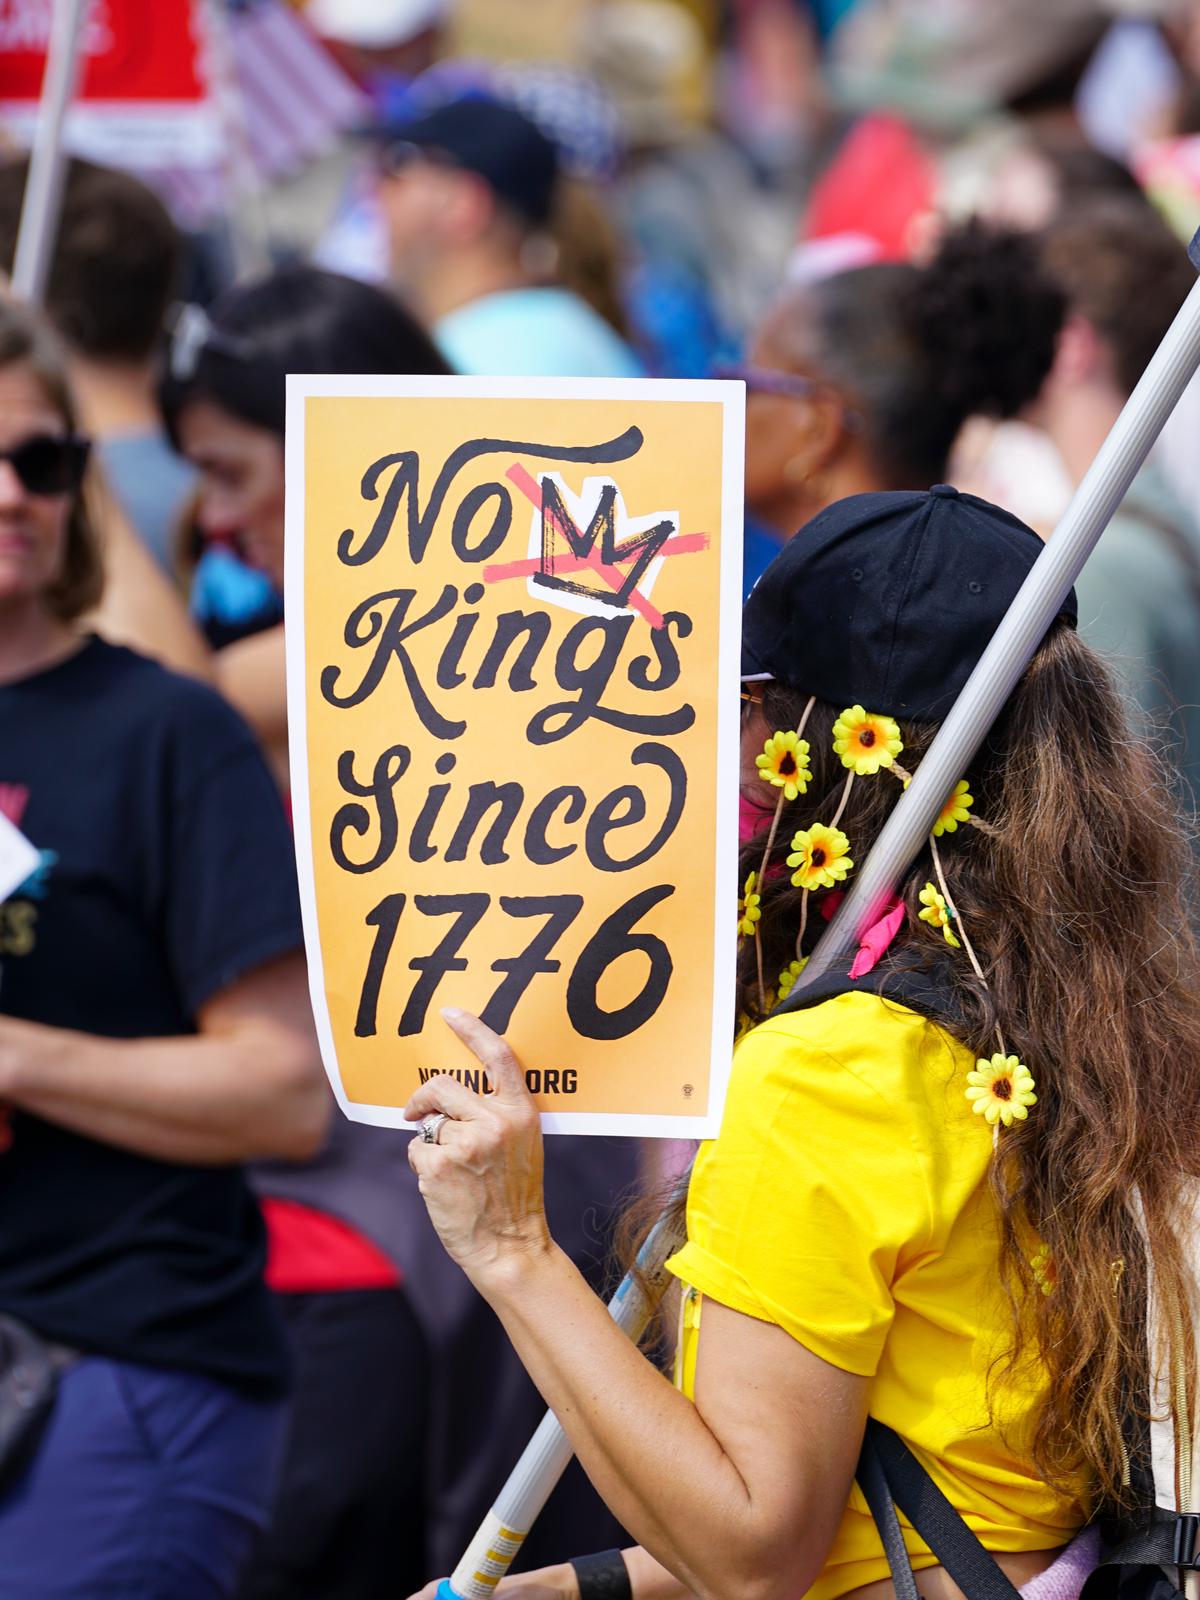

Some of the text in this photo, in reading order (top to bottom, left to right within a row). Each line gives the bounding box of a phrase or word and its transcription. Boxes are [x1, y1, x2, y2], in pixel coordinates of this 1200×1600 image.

[337, 425, 644, 567] No
[320, 583, 696, 745] Kings
[330, 742, 688, 874] Since
[354, 884, 676, 1041] 1776
